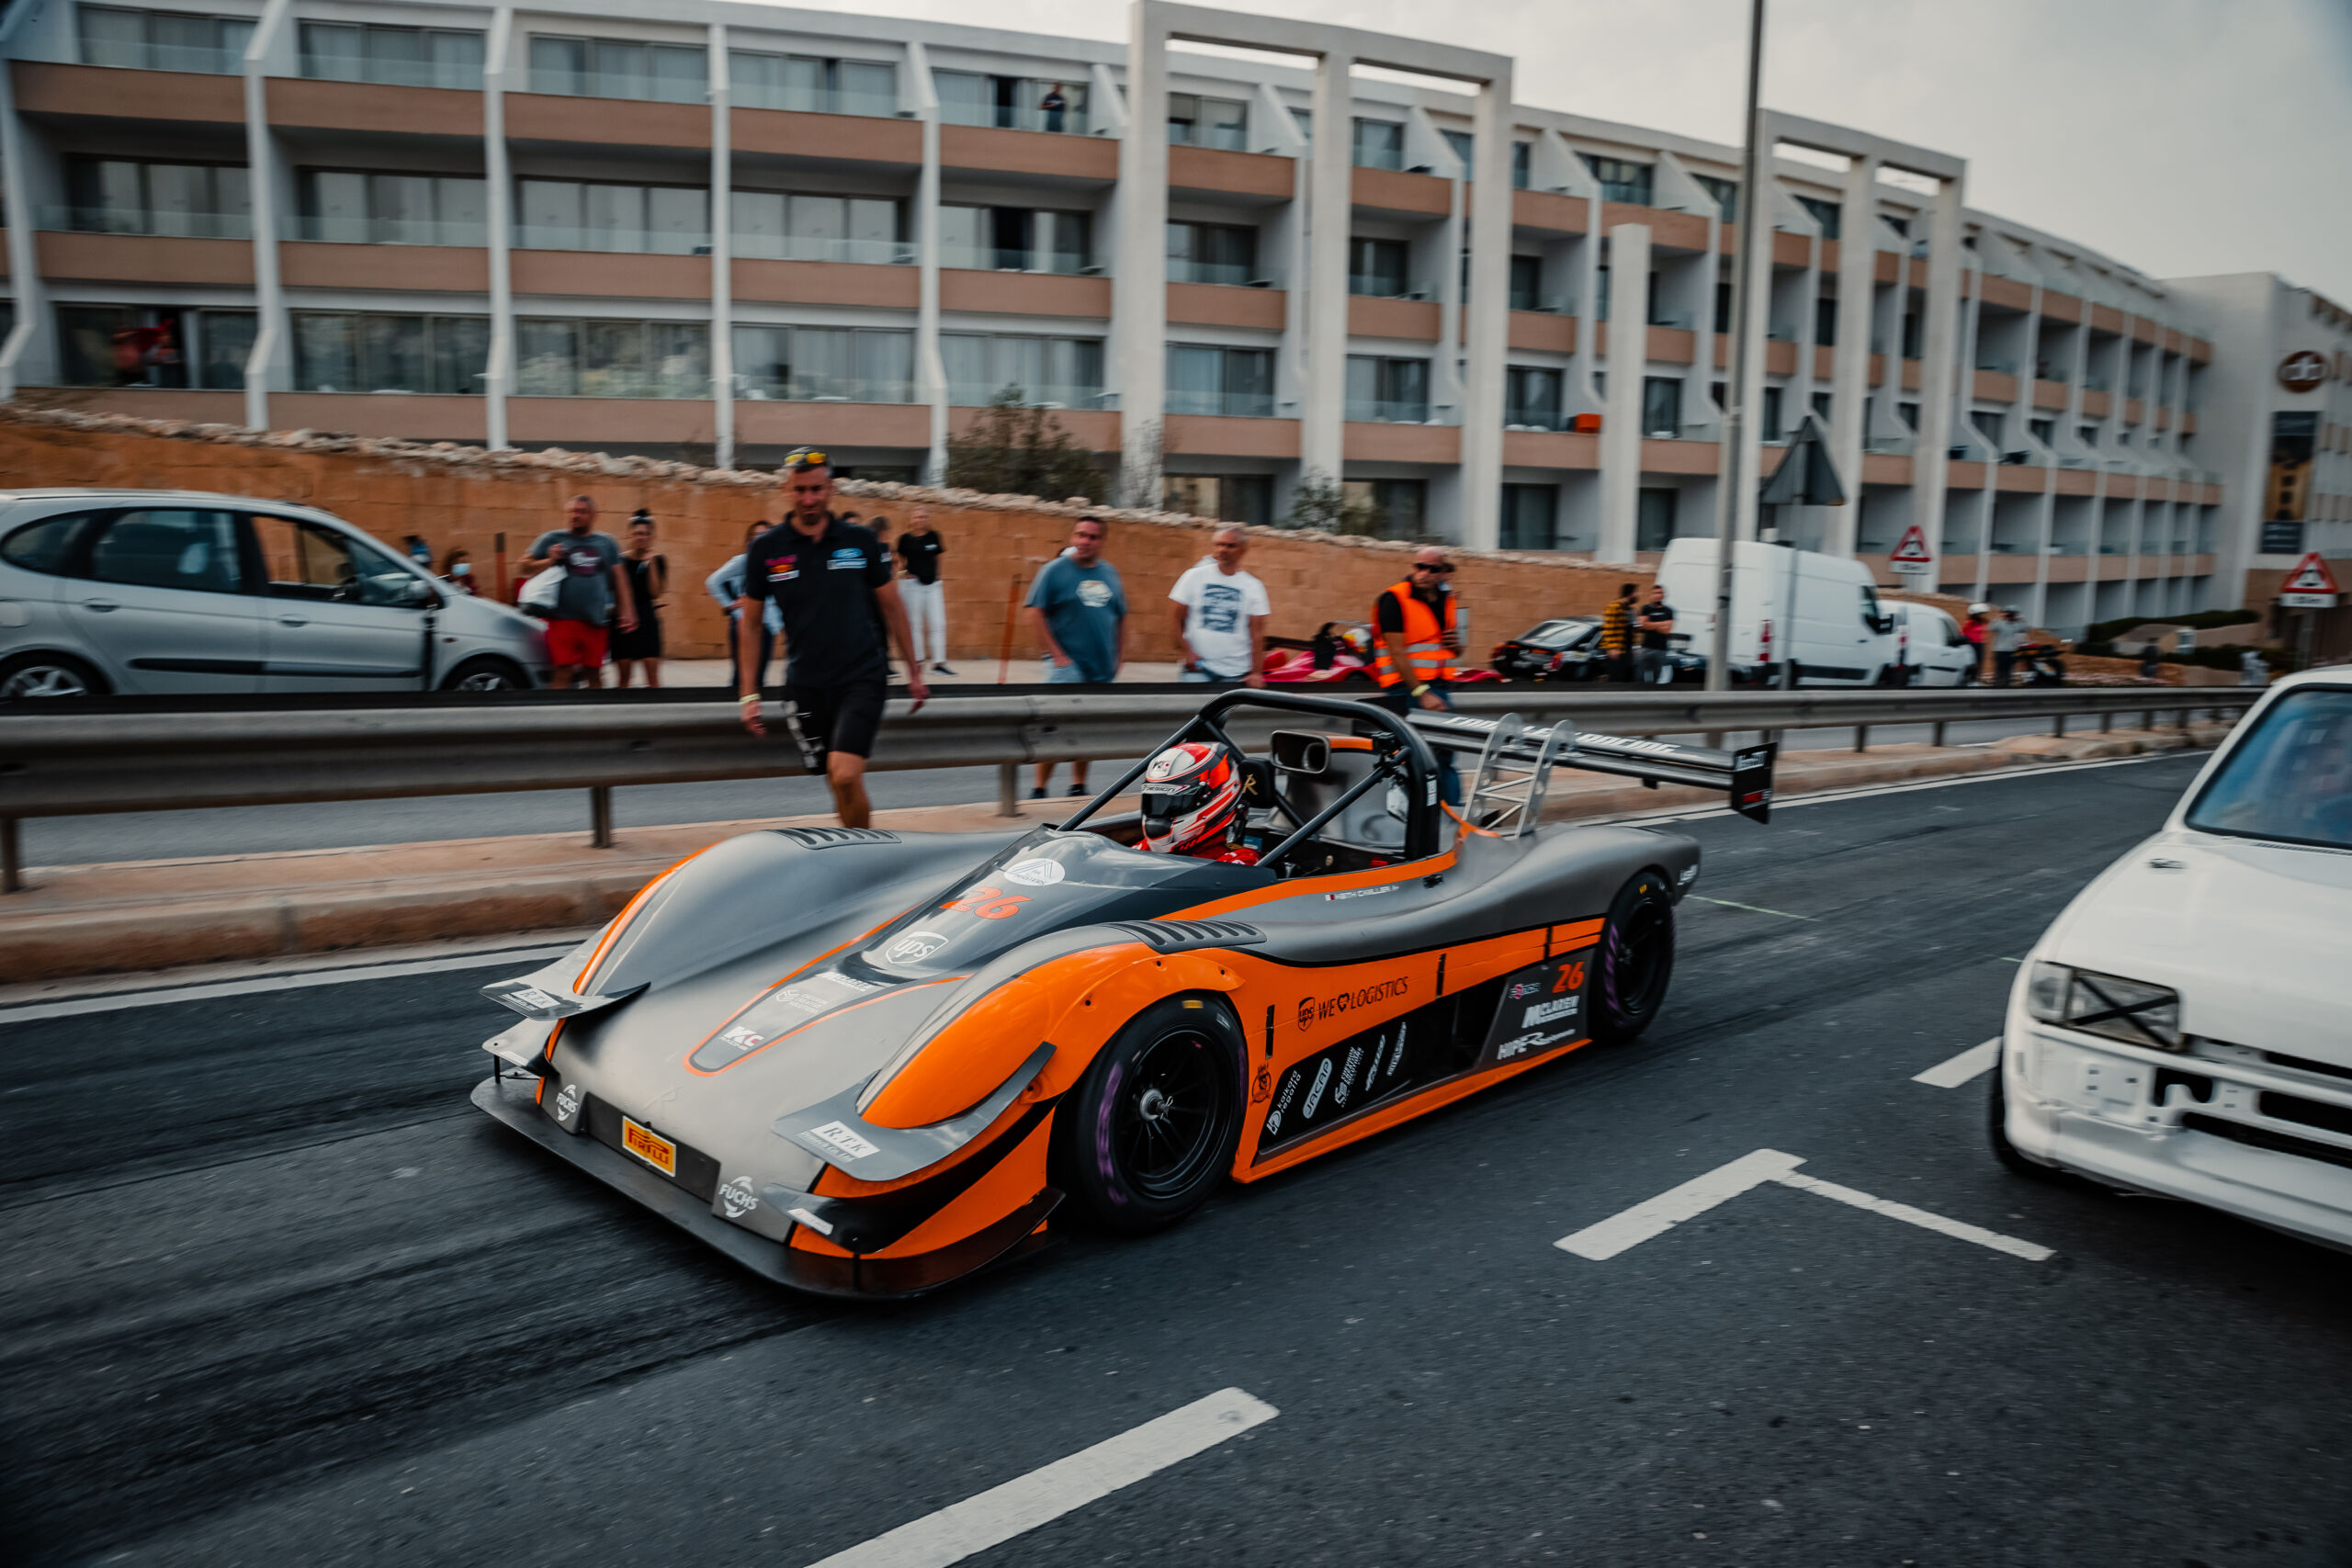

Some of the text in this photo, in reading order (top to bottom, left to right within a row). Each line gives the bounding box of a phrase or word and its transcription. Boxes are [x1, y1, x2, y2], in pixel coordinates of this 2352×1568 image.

[938, 886, 1034, 920] 26
[1551, 961, 1586, 994] 26
[1317, 998, 1337, 1021] WE
[1350, 976, 1409, 1010] LOGISTICS
[556, 1091, 579, 1114] FUCHS
[628, 1127, 670, 1165] PIRELLI
[718, 1183, 760, 1211] FUCHS
